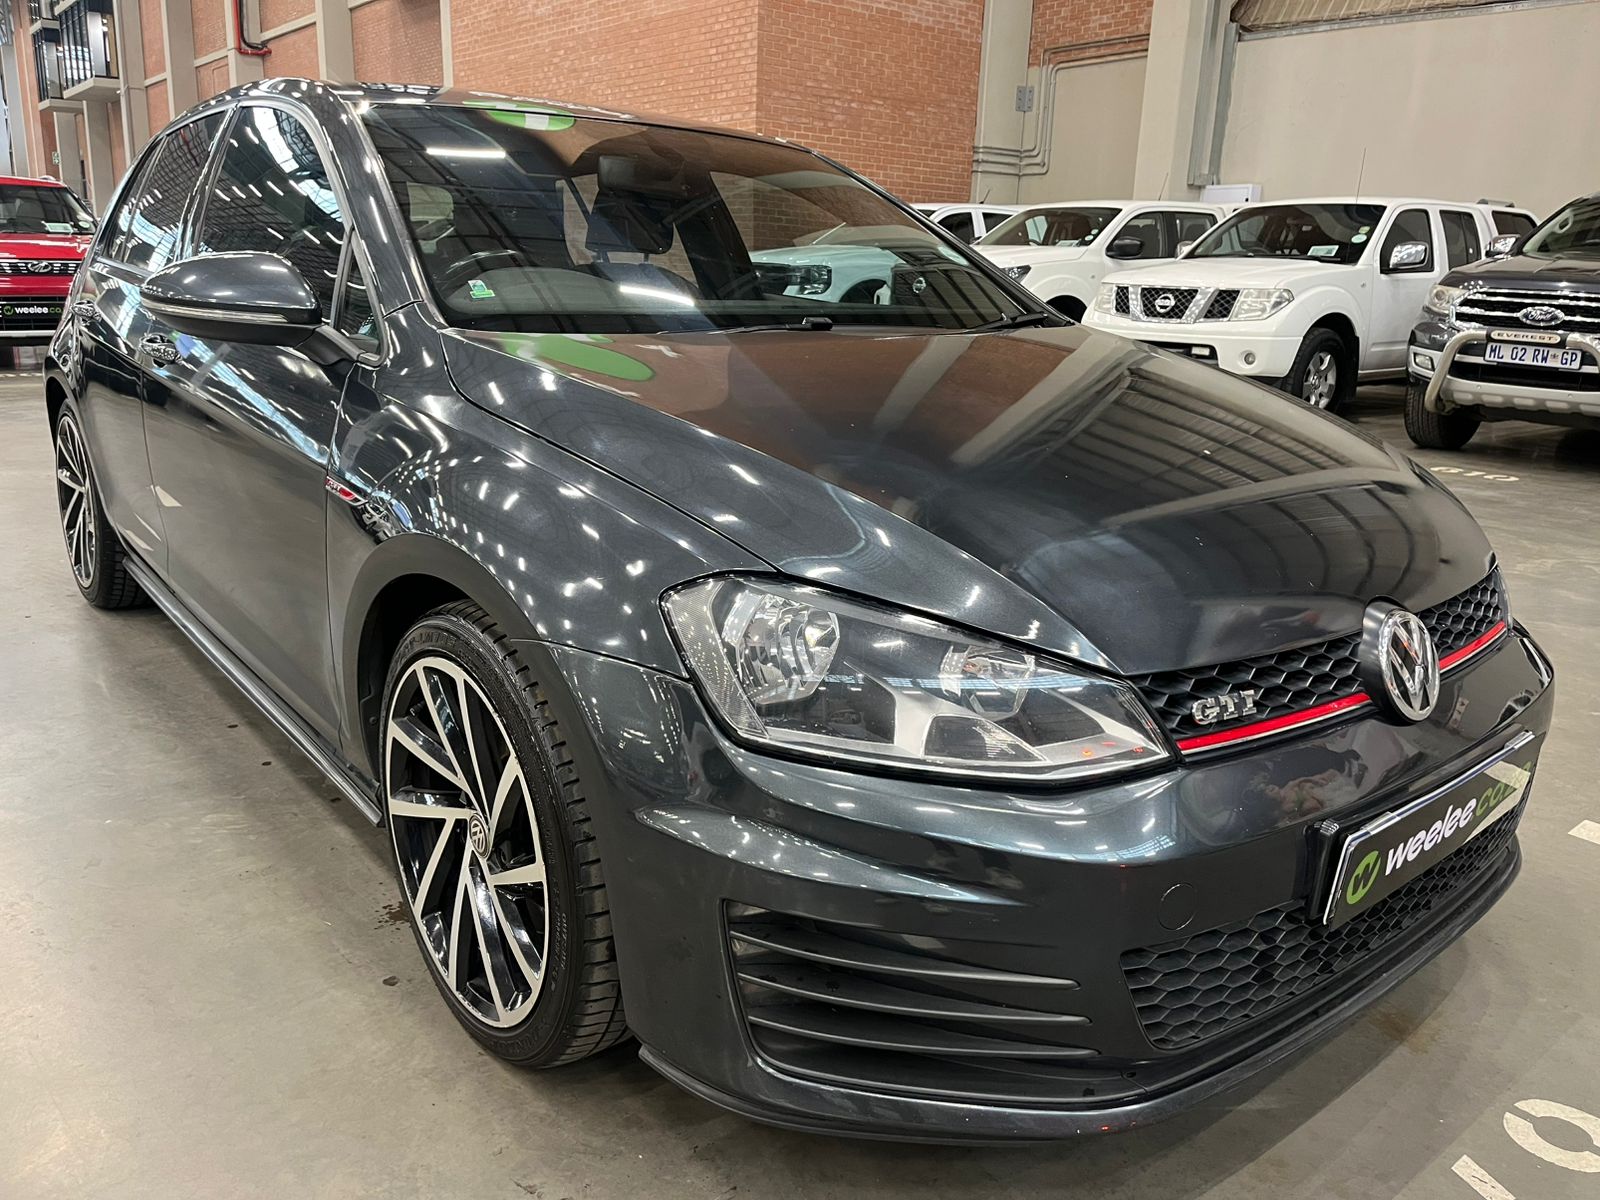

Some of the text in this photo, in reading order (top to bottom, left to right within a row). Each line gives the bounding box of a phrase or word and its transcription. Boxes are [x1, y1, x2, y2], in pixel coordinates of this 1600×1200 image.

[1497, 332, 1555, 341] EVEREST
[1511, 346, 1527, 362] 02
[1532, 348, 1550, 364] RW
[1560, 351, 1578, 367] GP
[1191, 689, 1258, 725] GTI
